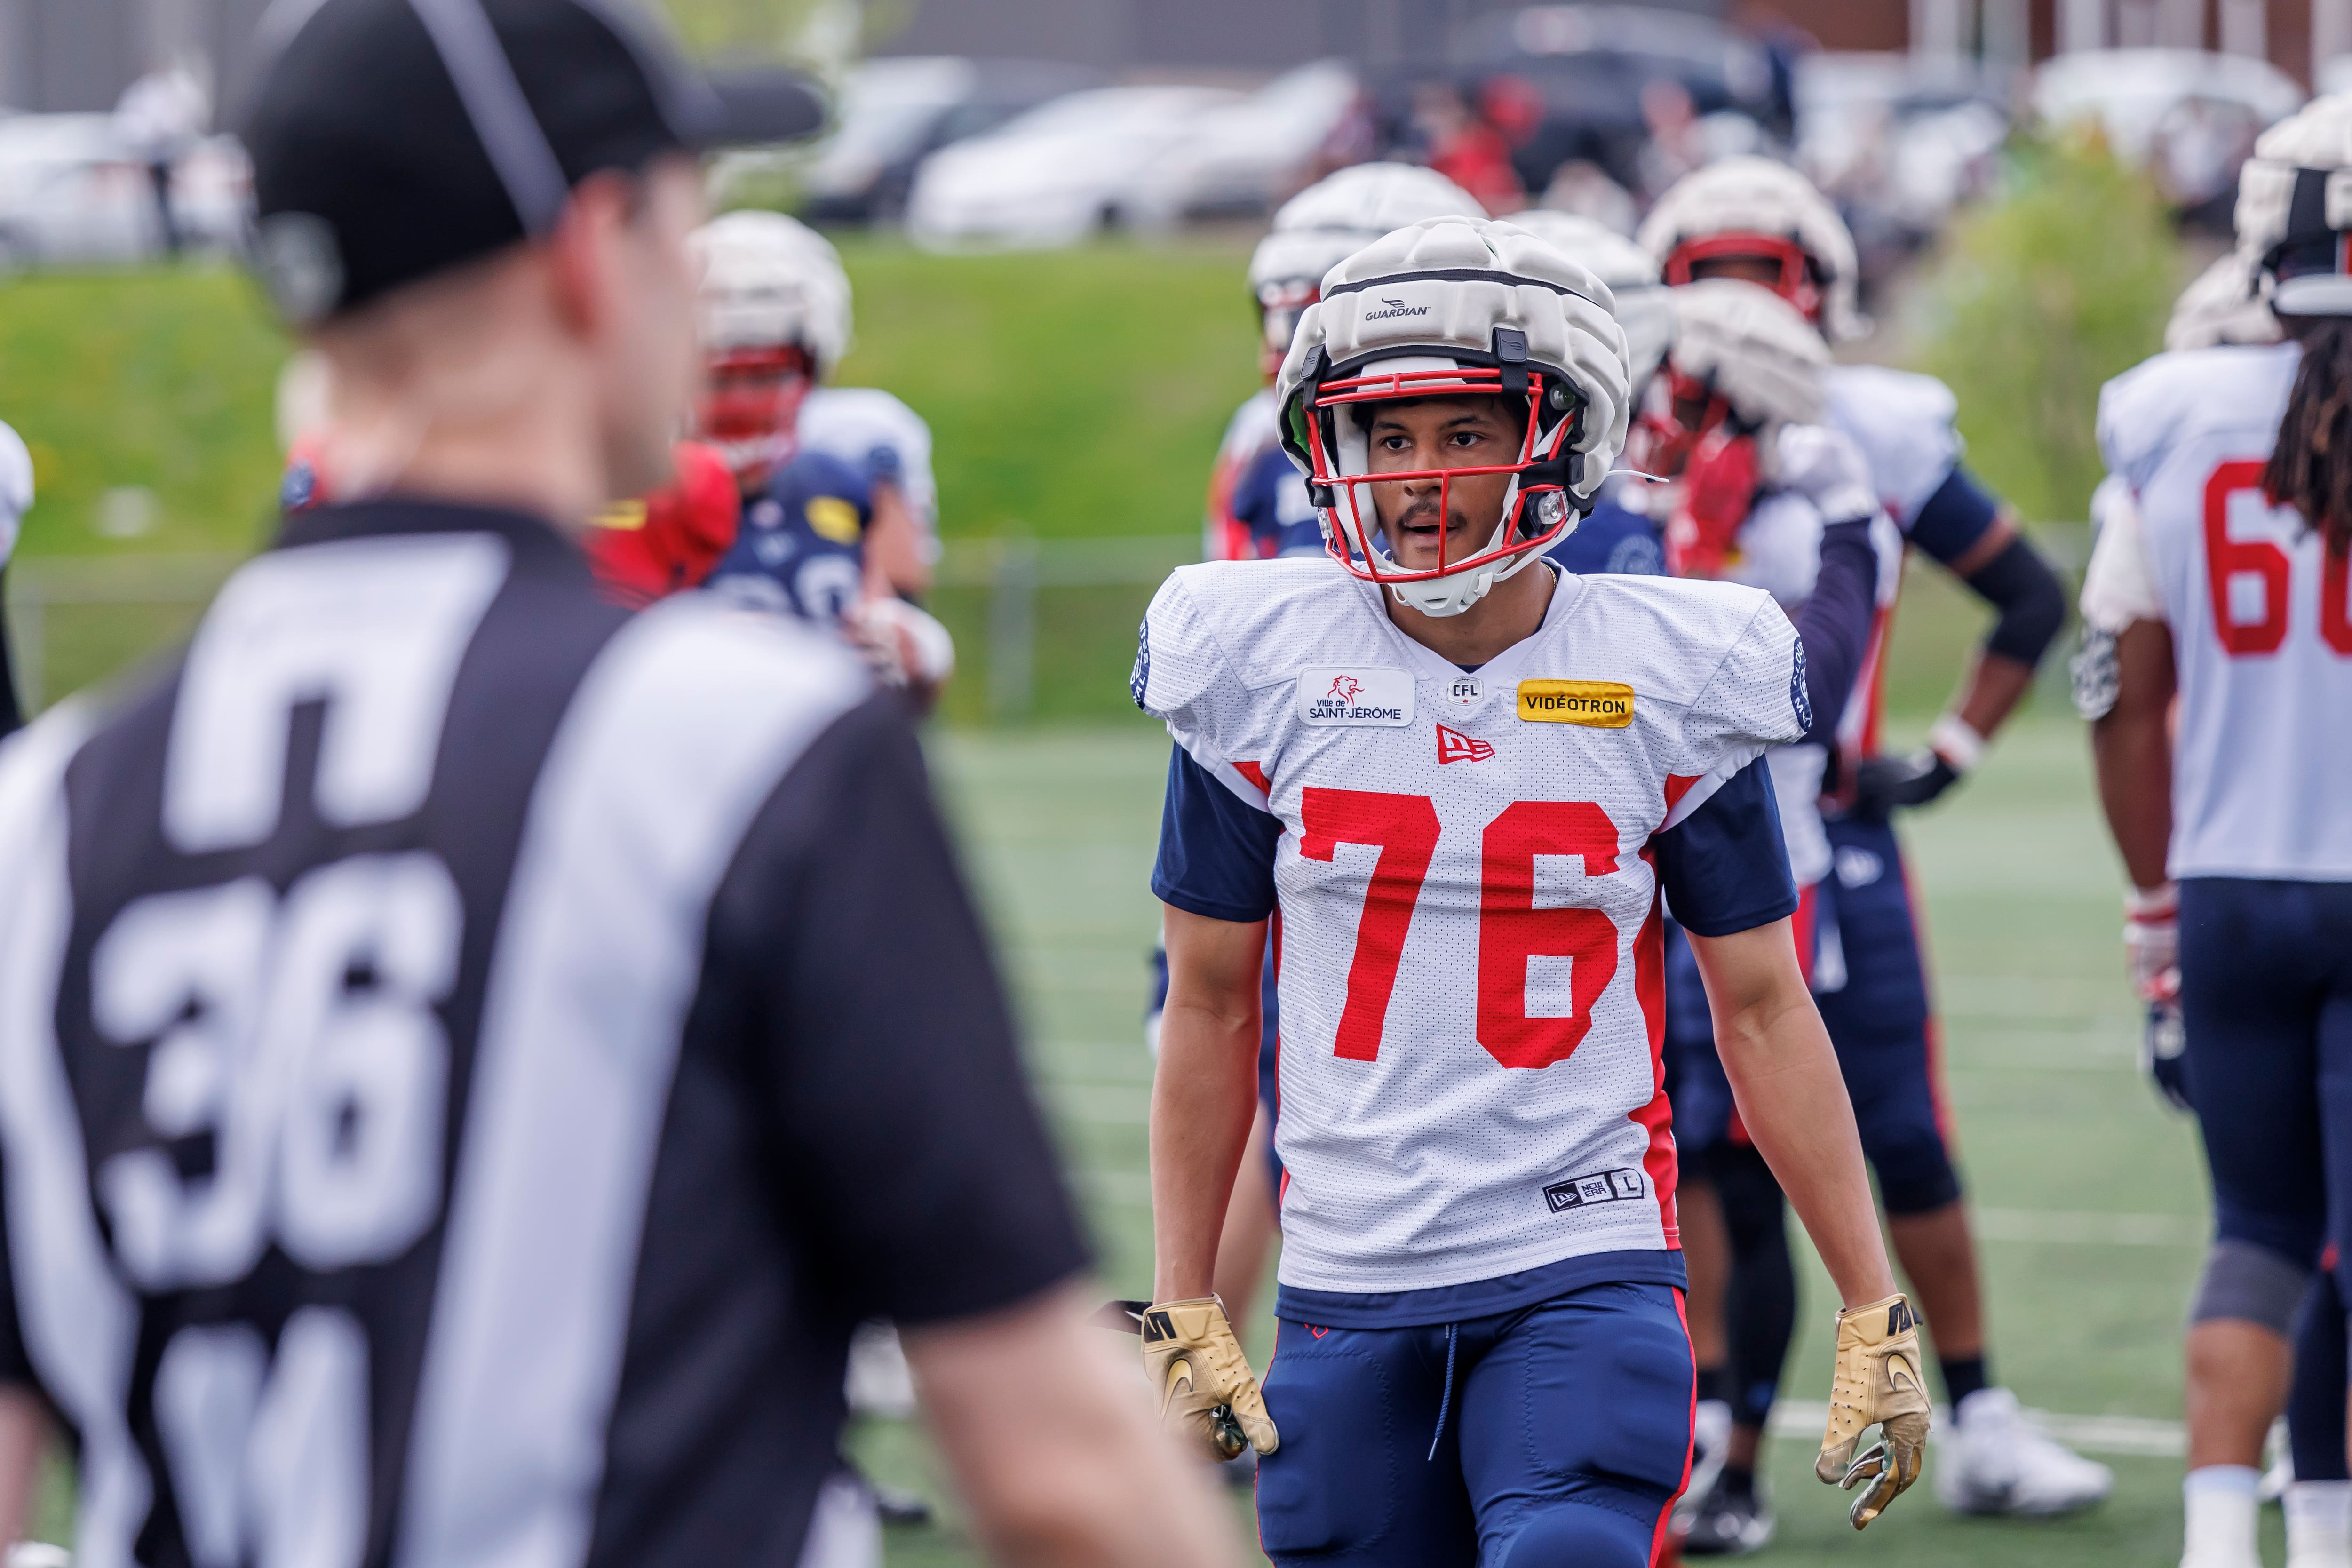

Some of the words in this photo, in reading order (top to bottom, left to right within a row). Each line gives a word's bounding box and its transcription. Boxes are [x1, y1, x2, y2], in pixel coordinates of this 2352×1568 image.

[2204, 461, 2352, 656] 6
[1453, 684, 1478, 697] CFL
[1526, 695, 1626, 714] VIDÉOTRON
[1309, 707, 1401, 720] SAINT-JÉRÔME
[1299, 786, 1621, 1070] 76
[89, 849, 465, 1293] 36
[1581, 1181, 1603, 1192] NEW
[1623, 1176, 1637, 1191] L
[1585, 1188, 1607, 1197] ERA
